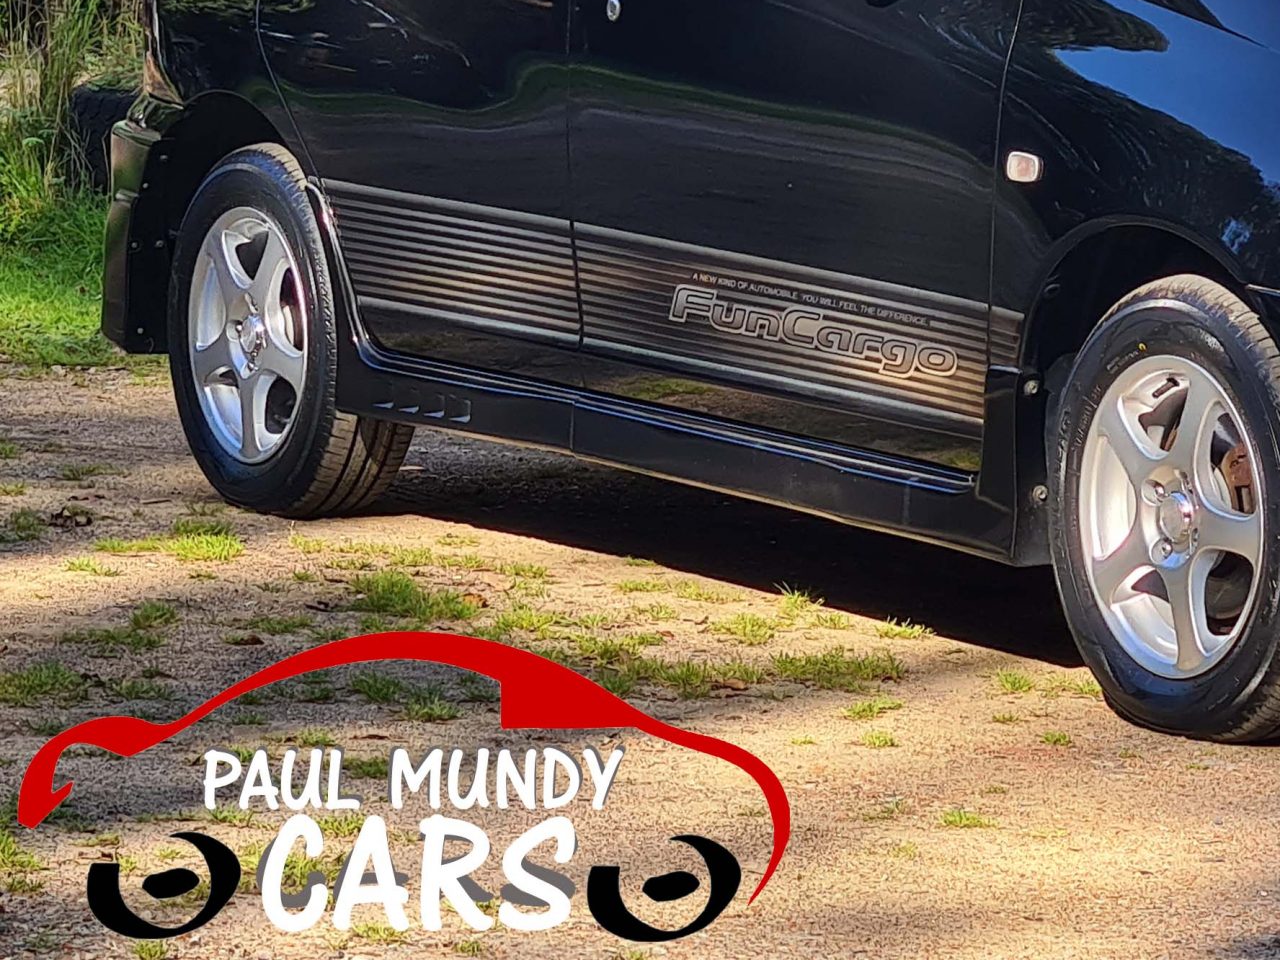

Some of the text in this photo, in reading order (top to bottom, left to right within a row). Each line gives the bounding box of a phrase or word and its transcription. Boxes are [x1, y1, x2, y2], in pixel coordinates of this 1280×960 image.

[700, 273, 718, 284] NEW
[718, 278, 737, 288] KIND
[737, 280, 749, 290] OF
[802, 294, 820, 304] YOU
[820, 296, 838, 308] WILL
[838, 300, 859, 312] FEEL
[860, 305, 876, 315] THE
[669, 284, 958, 379] FunCargo
